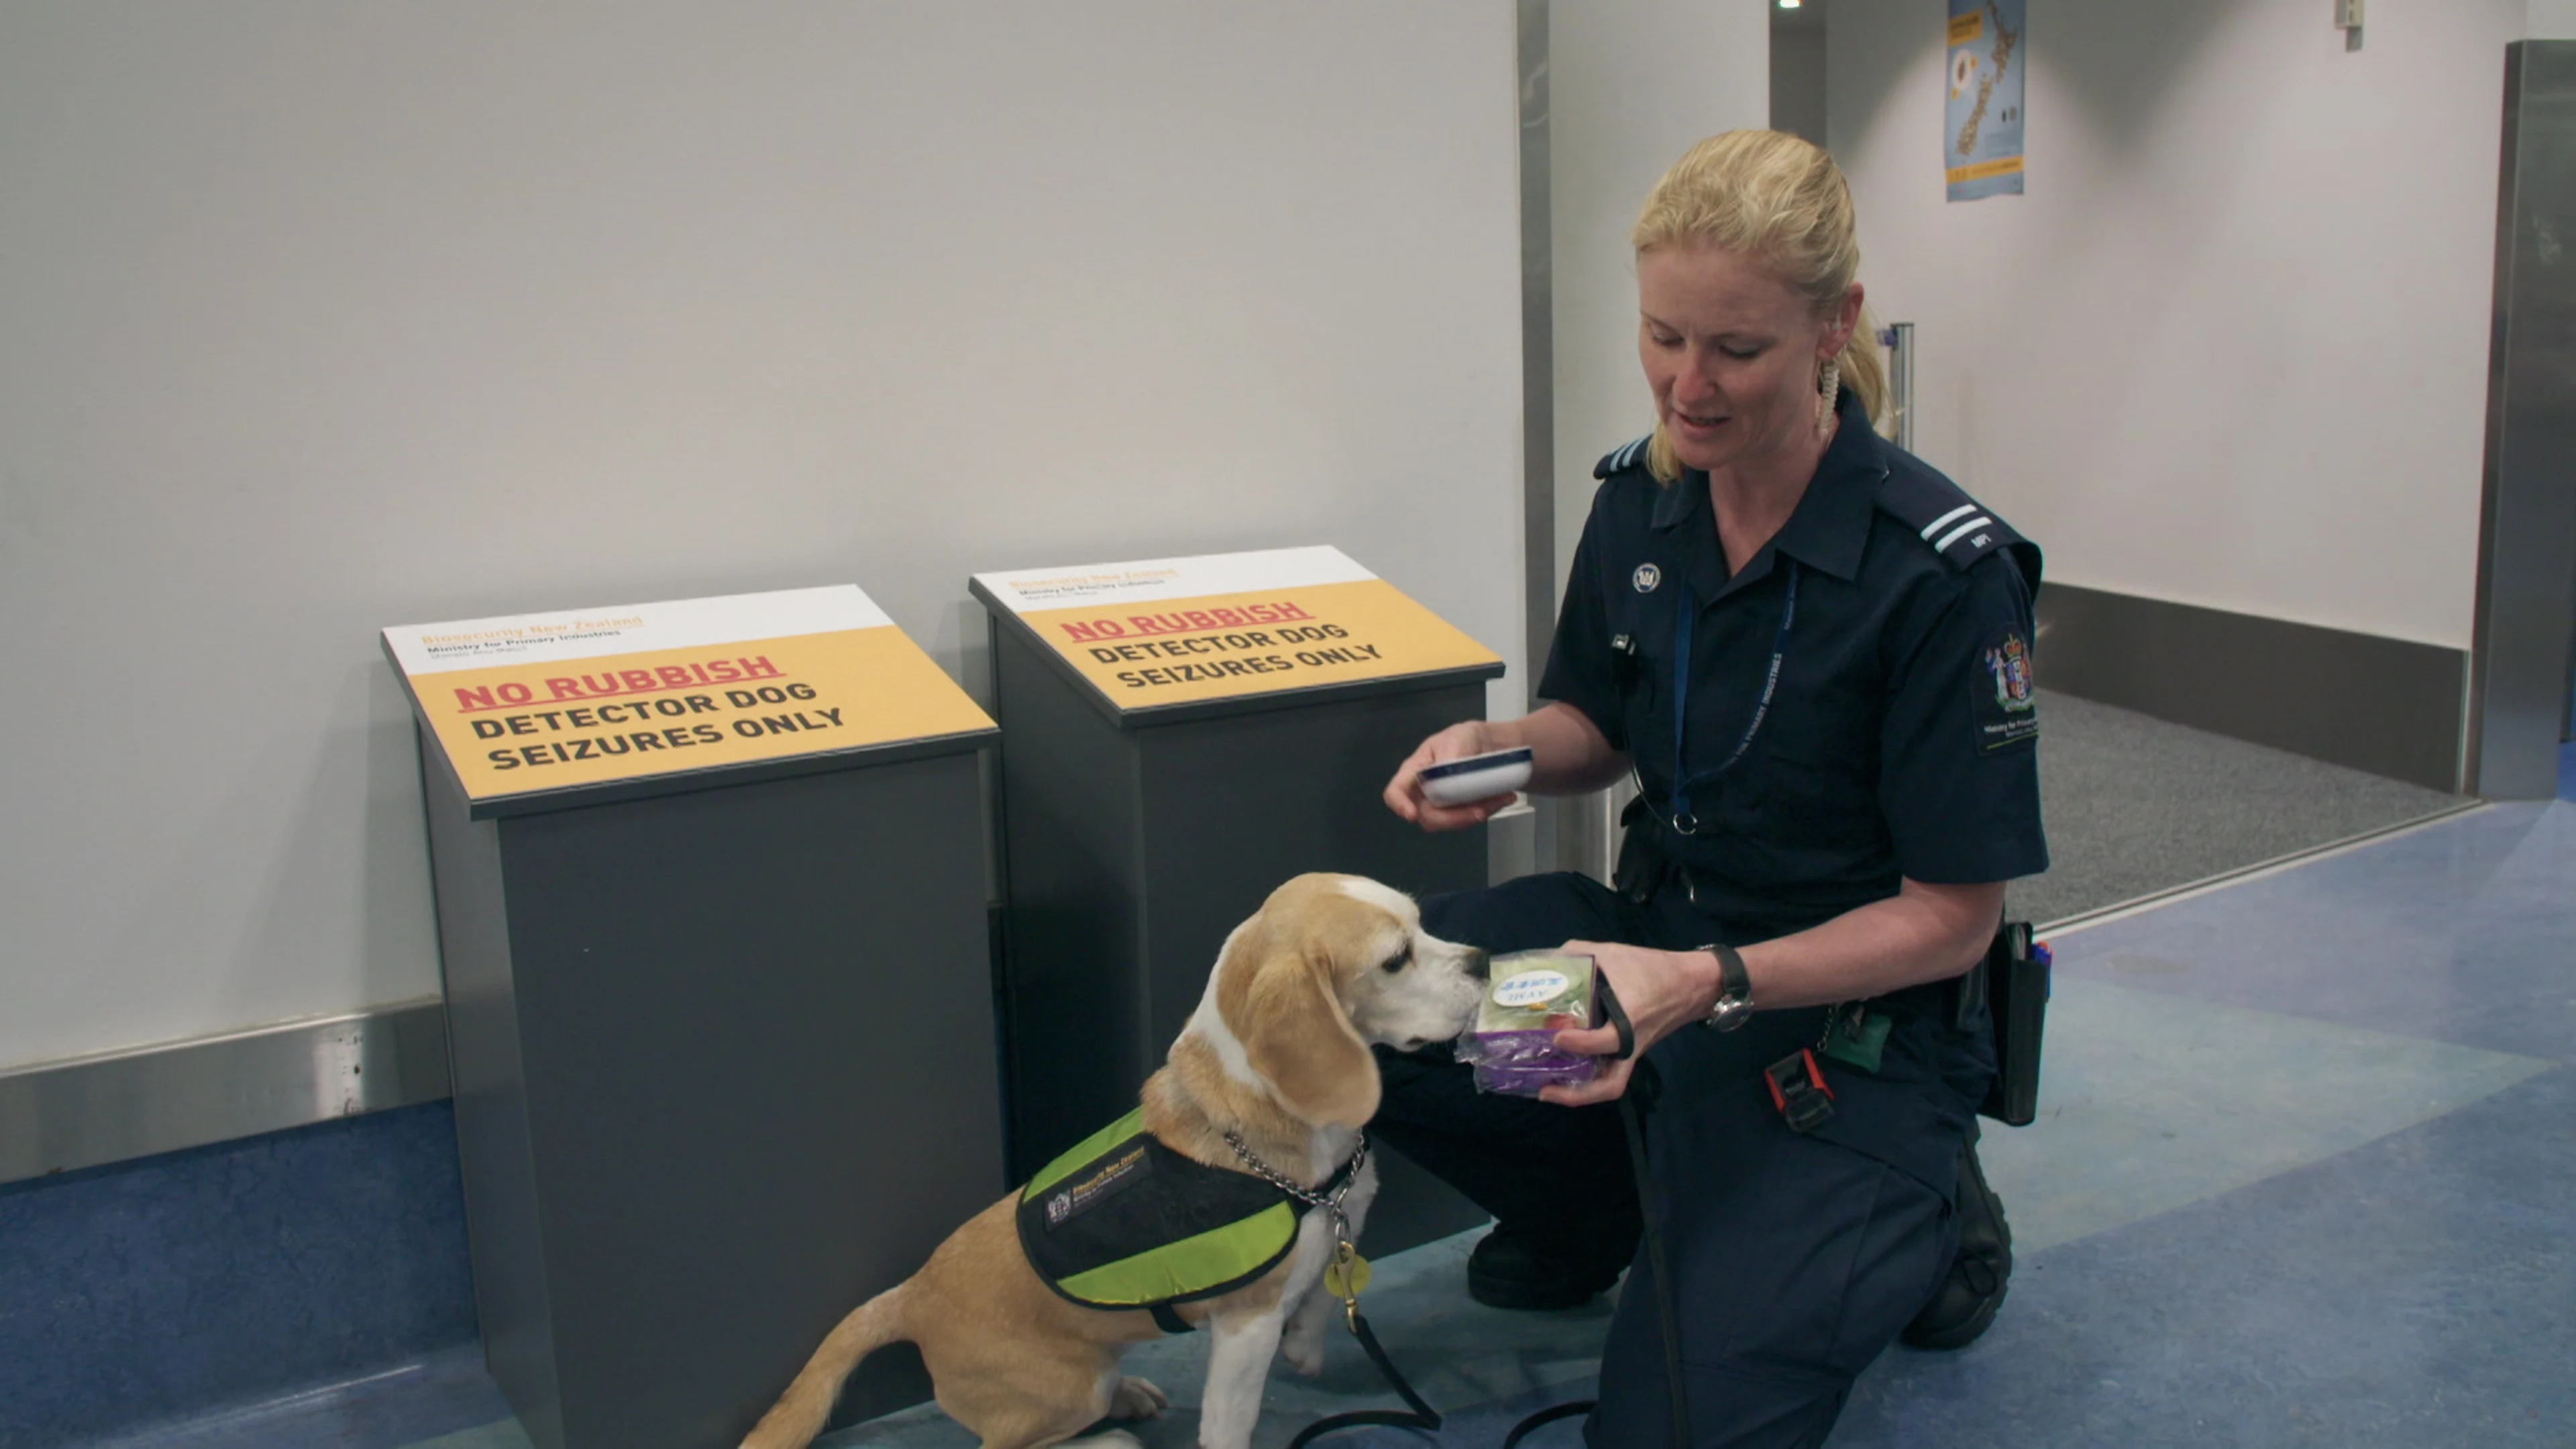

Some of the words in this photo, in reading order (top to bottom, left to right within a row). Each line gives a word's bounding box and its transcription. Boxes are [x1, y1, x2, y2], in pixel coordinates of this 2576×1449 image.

[421, 627, 524, 645] Biosecurity
[529, 623, 568, 634] New
[574, 615, 645, 630] Zealand
[427, 643, 480, 654] Ministry
[506, 636, 556, 646] Primary
[559, 630, 621, 641] Industries
[1060, 620, 1126, 642] NO
[1128, 602, 1309, 636] RUBBISH
[1088, 631, 1277, 664] DETECTOR
[1275, 624, 1350, 645] DOG
[453, 682, 533, 710] NO
[544, 655, 780, 700] RUBBISH
[1116, 655, 1295, 688] SEIZURES
[1295, 644, 1383, 667] ONLY
[1760, 652, 1782, 705] INDUSTRIES
[470, 694, 721, 740] DETECTOR
[724, 683, 817, 708] DOG
[487, 723, 724, 770] SEIZURES
[732, 706, 845, 739] ONLY
